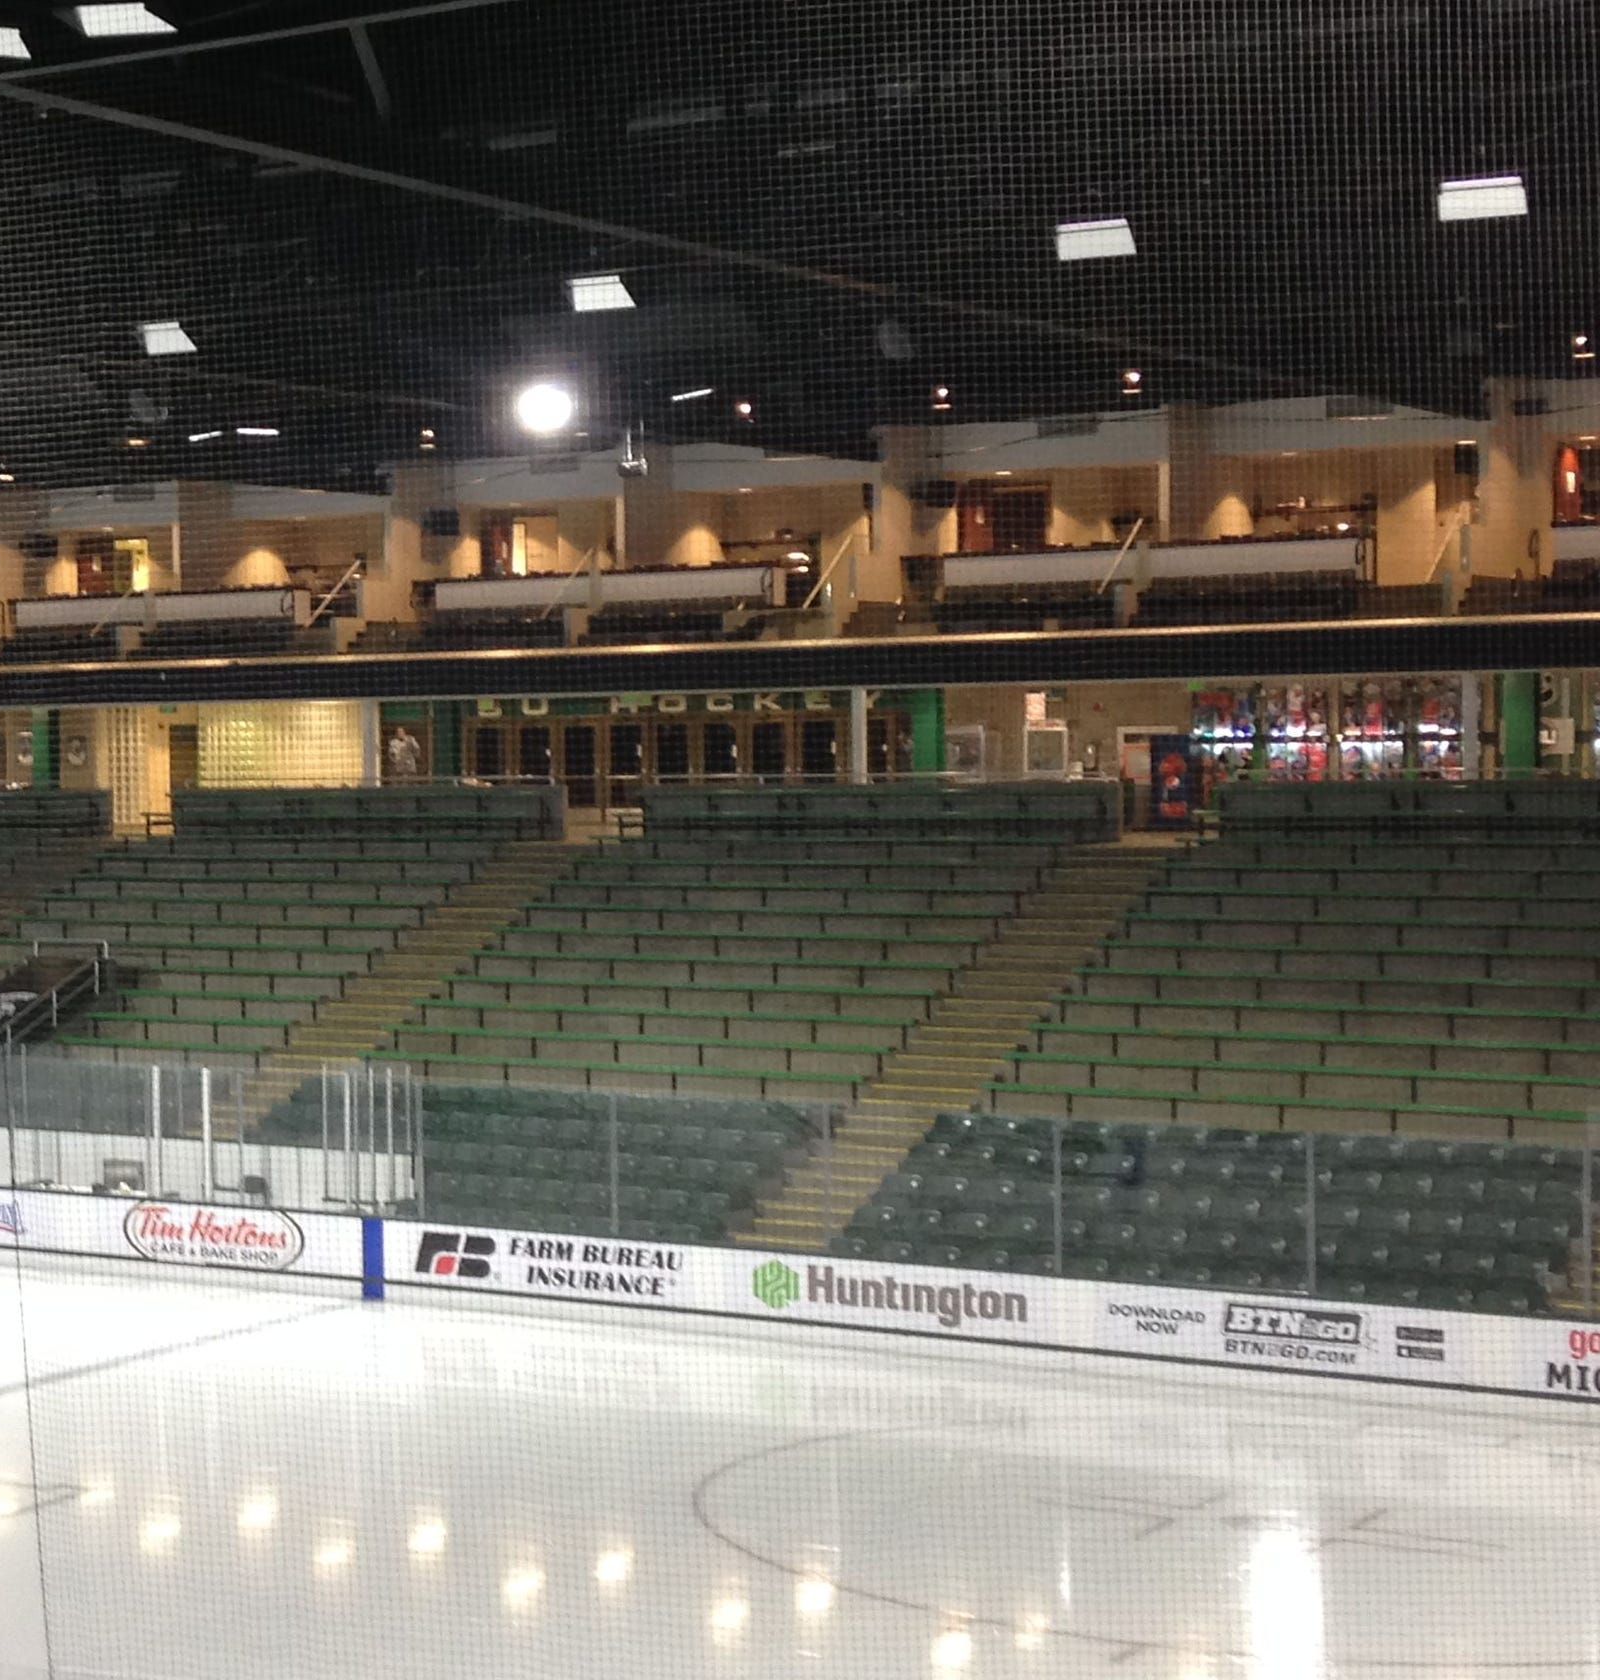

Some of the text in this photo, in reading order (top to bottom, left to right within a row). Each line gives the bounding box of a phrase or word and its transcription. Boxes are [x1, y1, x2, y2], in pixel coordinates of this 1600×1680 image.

[139, 1206, 288, 1248] Tim Hortons
[241, 1249, 279, 1265] SHOP
[509, 1238, 683, 1271] FARM BUREAU
[807, 1264, 1028, 1328] Huntington
[1109, 1303, 1206, 1324] DOWNLOAD
[1136, 1320, 1179, 1335] NOW
